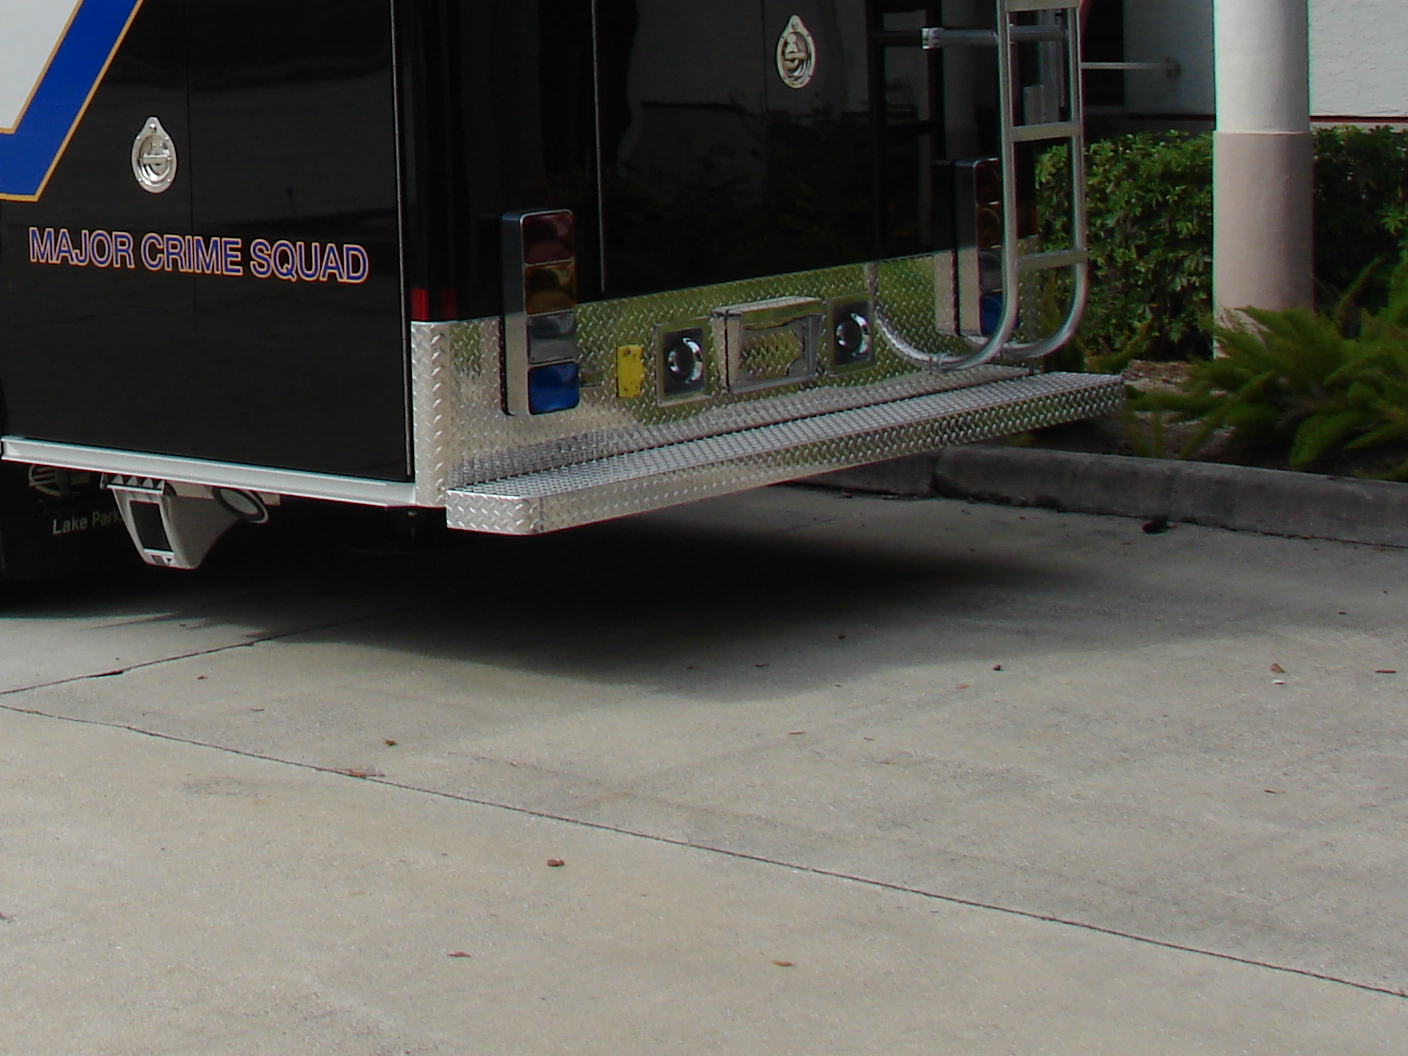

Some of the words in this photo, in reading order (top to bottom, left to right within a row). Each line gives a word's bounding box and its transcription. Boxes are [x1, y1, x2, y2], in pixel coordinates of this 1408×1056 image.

[29, 227, 135, 269] MAJOR
[141, 232, 243, 276] CRIME
[249, 239, 369, 284] SQUAD
[52, 515, 88, 535] Lake
